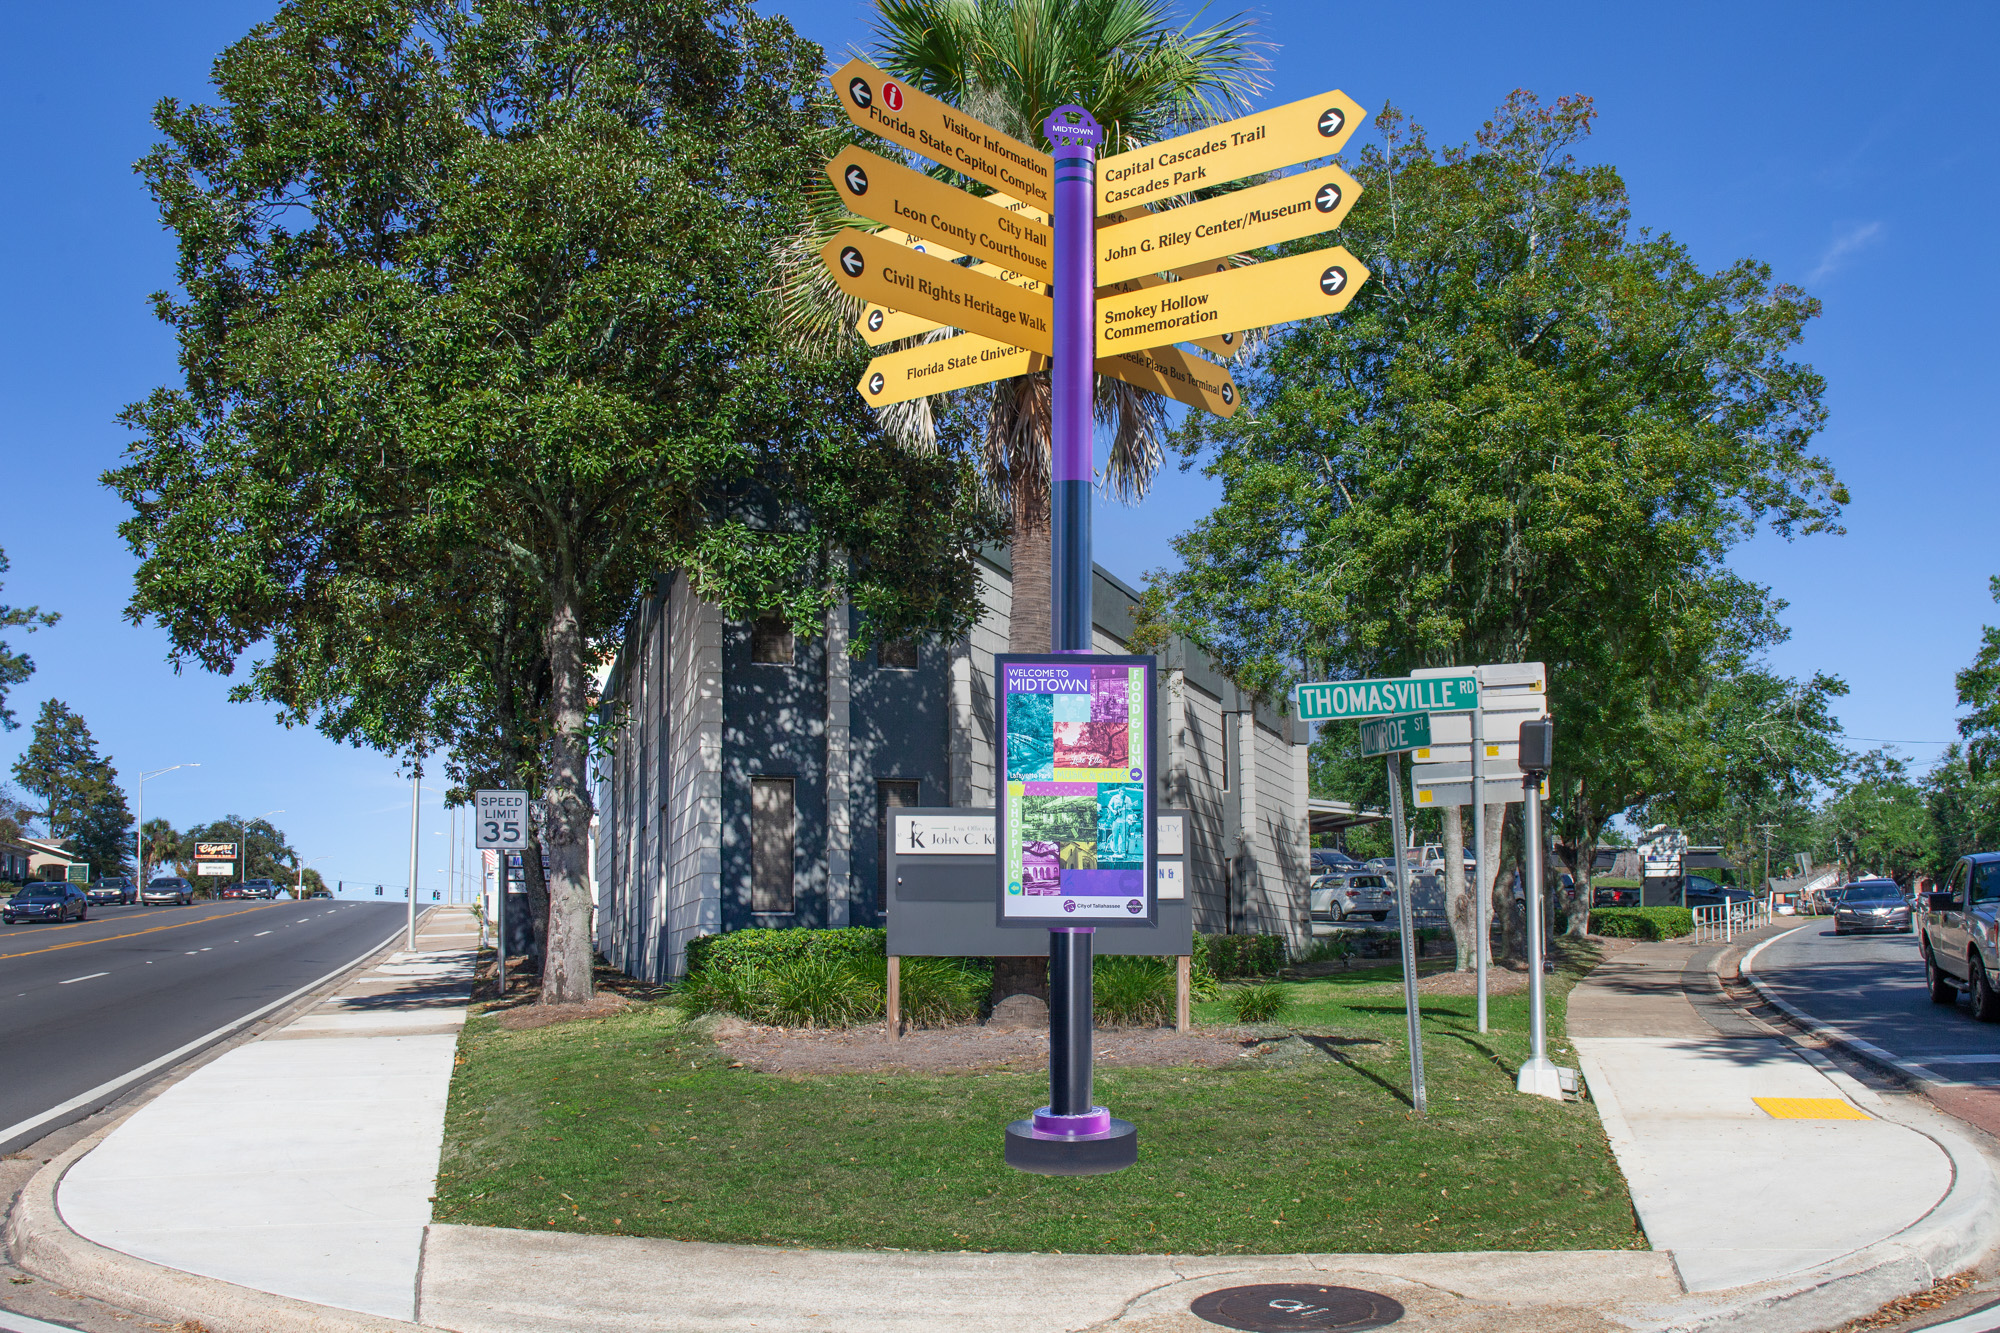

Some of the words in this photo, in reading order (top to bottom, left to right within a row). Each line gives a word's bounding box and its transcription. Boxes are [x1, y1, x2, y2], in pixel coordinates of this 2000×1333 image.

[943, 114, 981, 144] Visitor
[984, 135, 1048, 177] Information
[1052, 125, 1094, 136] MIDTOWN
[869, 105, 915, 138] Florida
[919, 129, 953, 156] State
[955, 147, 997, 177] Capitol
[1000, 168, 1047, 201] Complex
[1105, 158, 1155, 182] Capital
[1158, 139, 1227, 167] Cascades
[1231, 125, 1266, 147] Trail
[1105, 177, 1169, 203] Cascades
[1173, 166, 1207, 186] Park
[894, 199, 927, 224] Leon
[931, 215, 977, 245] County
[980, 233, 1047, 269] Courthouse
[998, 217, 1021, 239] City
[1025, 227, 1047, 247] Hall
[1104, 245, 1137, 262] John
[1140, 239, 1155, 252] G.
[1158, 229, 1192, 248] Riley
[1195, 199, 1312, 239] Center/Museum
[883, 267, 914, 290] Civil
[919, 278, 960, 304] Rights
[964, 293, 1016, 323] Heritage
[1019, 311, 1047, 333] Walk
[1104, 303, 1158, 324] Smokey
[1161, 293, 1209, 314] Hollow
[1104, 308, 1218, 340] Commemoration
[907, 362, 944, 380] Florida
[947, 354, 977, 370] State
[980, 345, 1029, 361] Univers
[1146, 357, 1168, 375] Plaza
[1170, 366, 1186, 382] Bus
[1186, 372, 1220, 395] Terminal
[1008, 669, 1054, 677] WELCOME
[1056, 669, 1069, 678] TO
[1009, 678, 1088, 692] MIDTOWN
[1131, 669, 1141, 714] FOOD
[1302, 681, 1456, 716] THOMASVILLE
[1459, 680, 1475, 694] RD
[1131, 718, 1141, 729] &
[1363, 719, 1409, 752] MONROE
[1414, 716, 1424, 731] ST
[1131, 732, 1141, 766] FUN
[1056, 770, 1088, 780] MUSIC
[481, 797, 523, 806] SPEED
[485, 810, 518, 818] LIMIT
[483, 821, 520, 842] 35
[1011, 798, 1019, 880] SHOPPING
